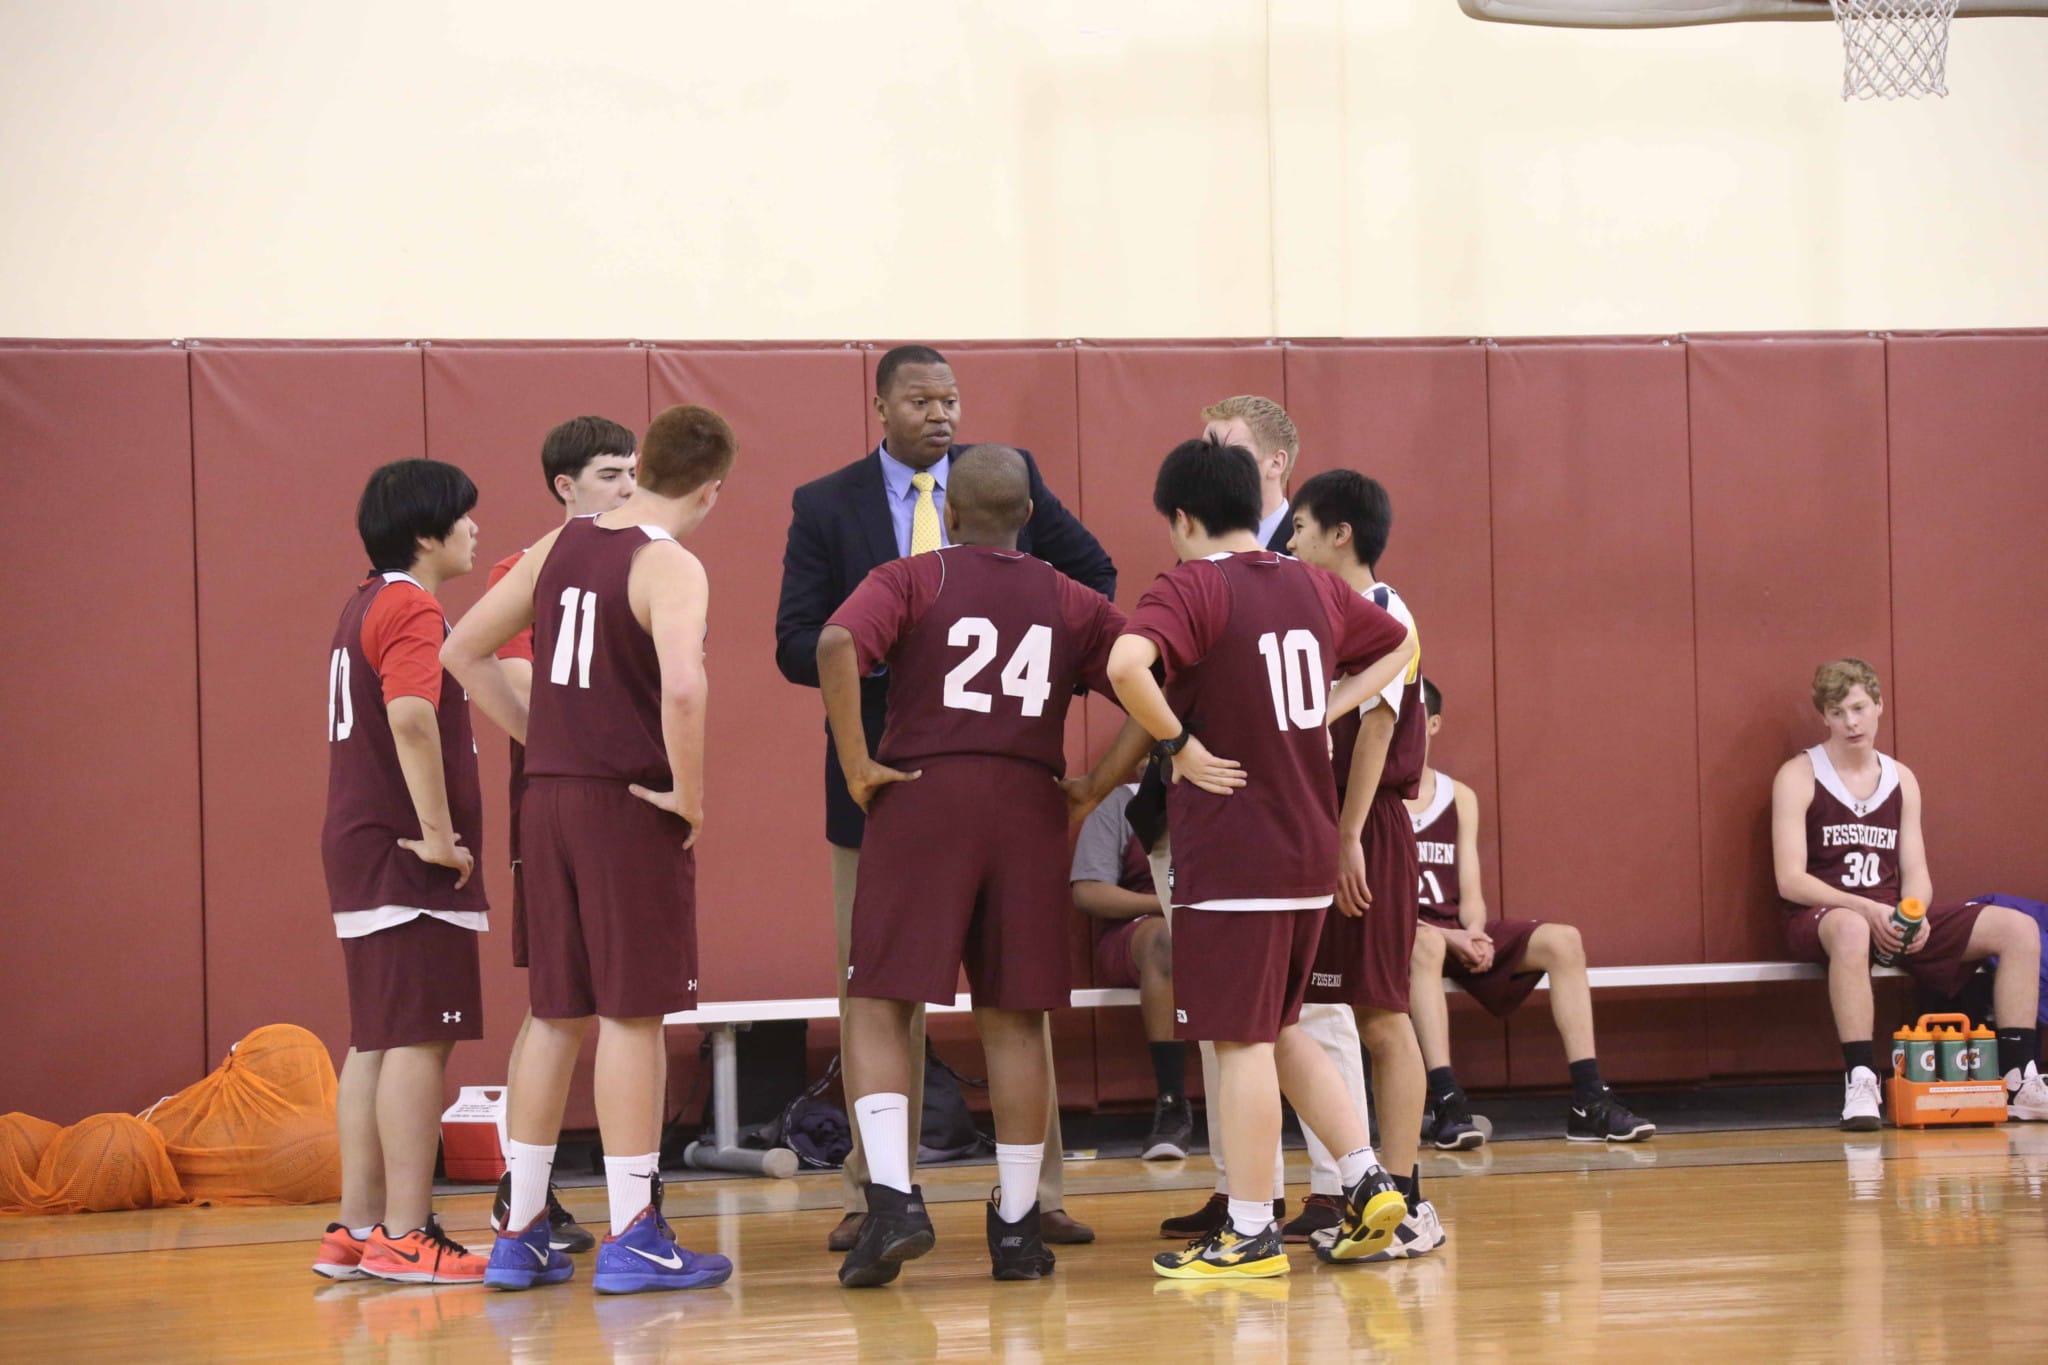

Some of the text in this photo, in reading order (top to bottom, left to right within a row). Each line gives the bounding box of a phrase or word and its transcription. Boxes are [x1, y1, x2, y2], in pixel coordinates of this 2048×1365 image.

[550, 587, 597, 689] 11
[943, 617, 1052, 717] 24
[1258, 629, 1326, 731] 10
[1841, 852, 1881, 887] 30
